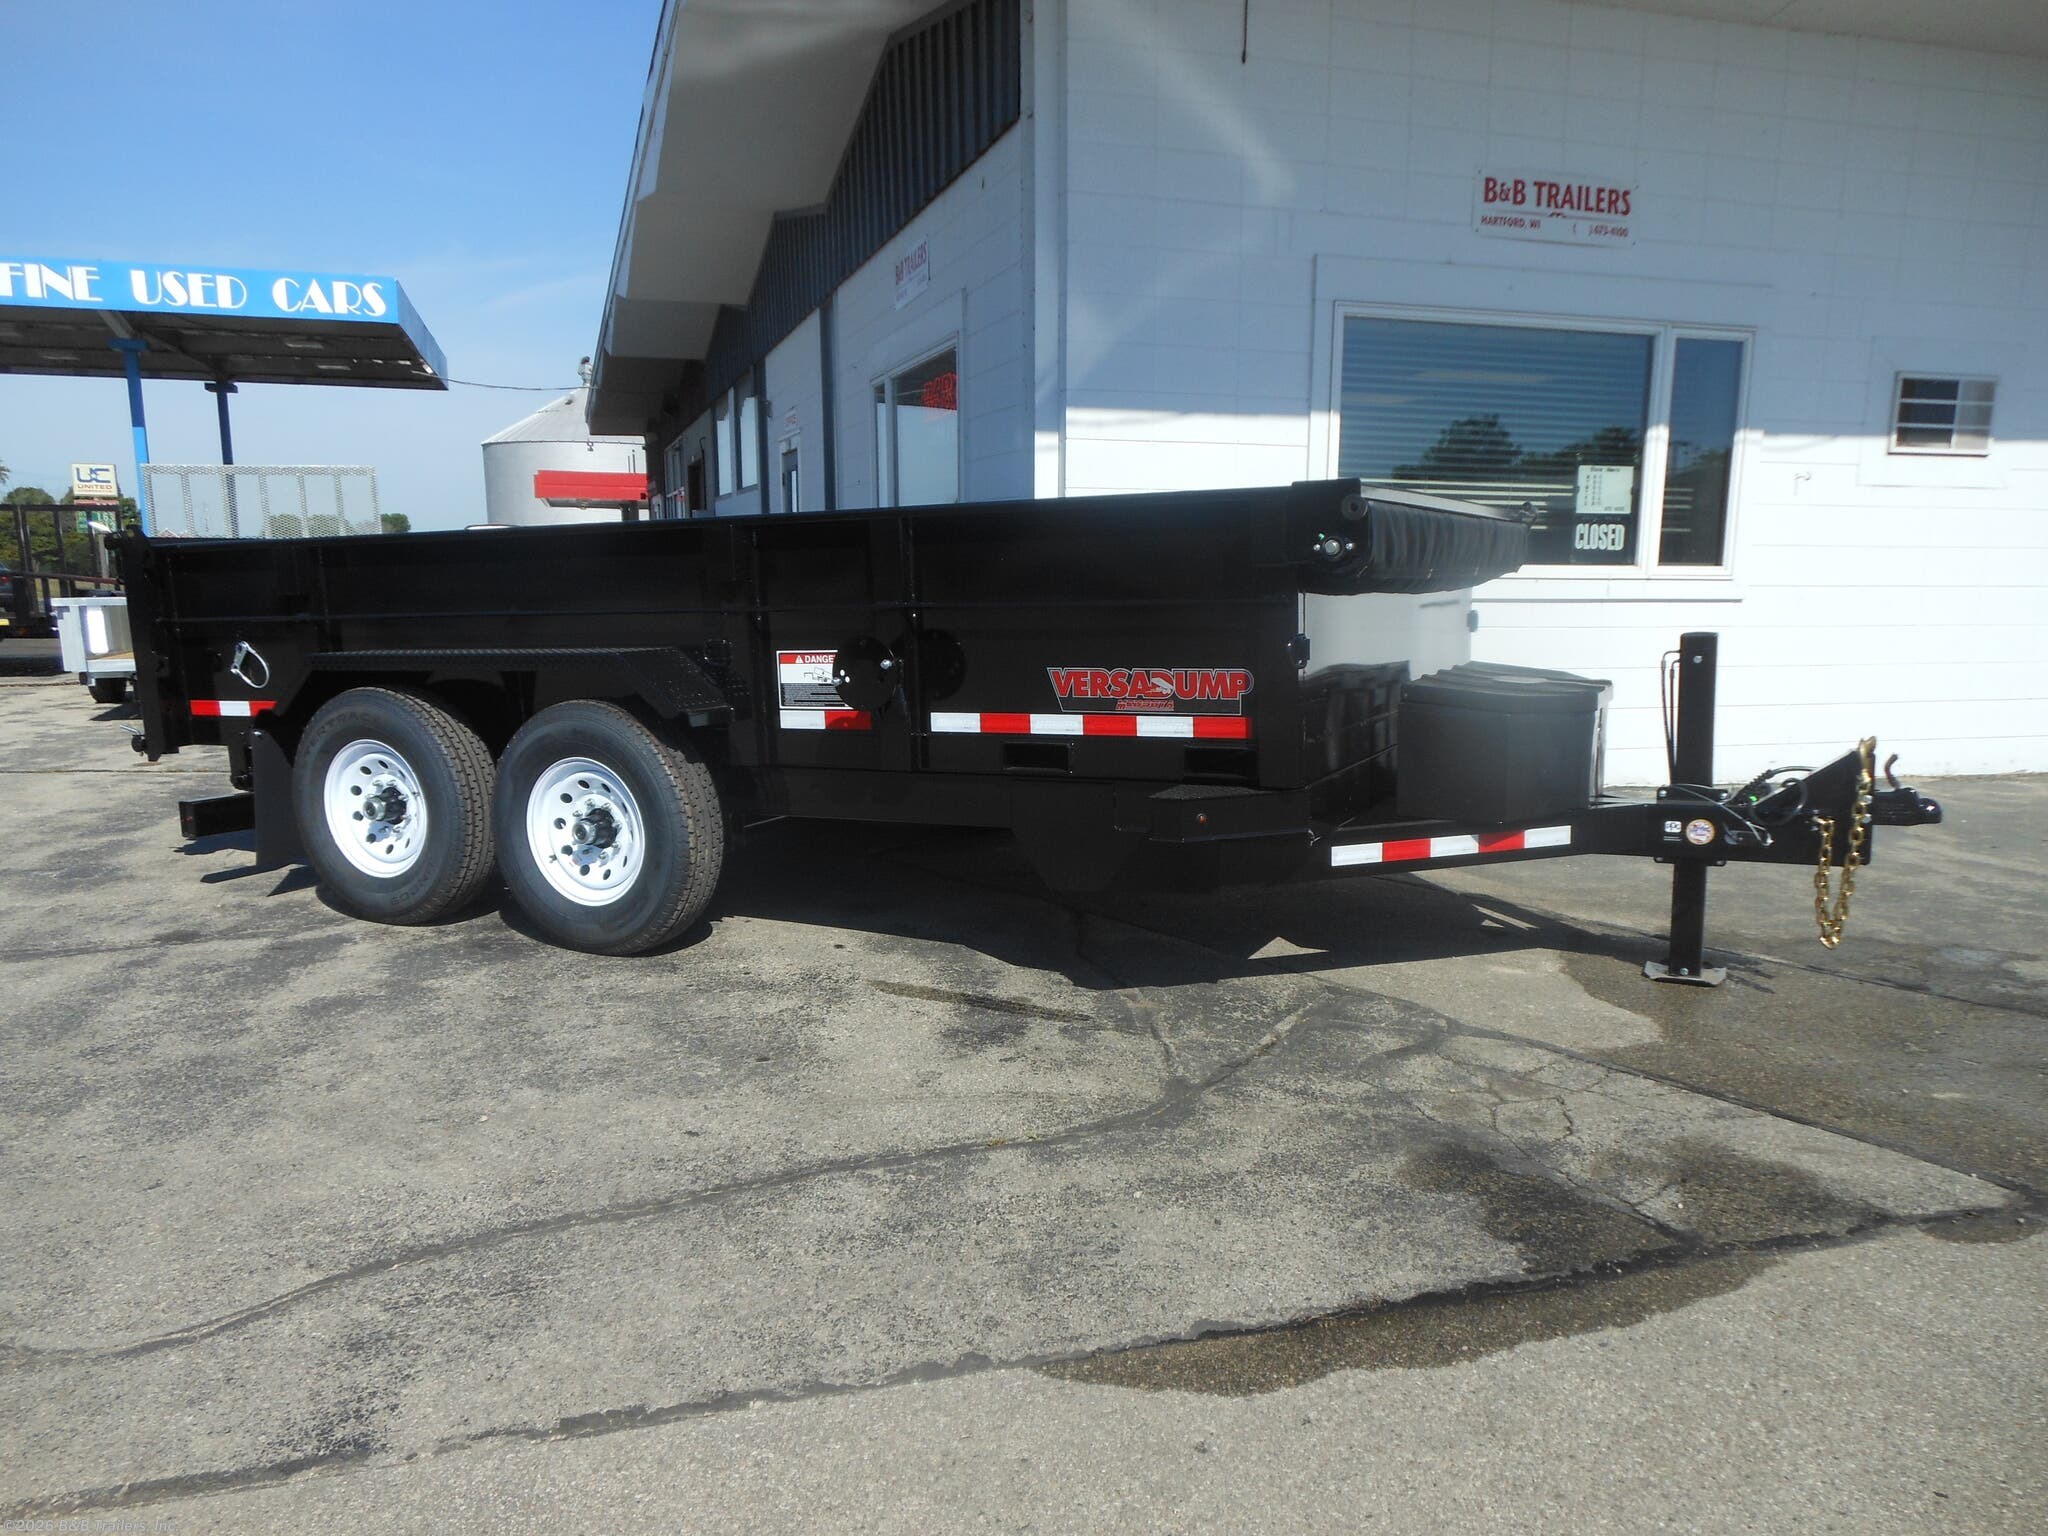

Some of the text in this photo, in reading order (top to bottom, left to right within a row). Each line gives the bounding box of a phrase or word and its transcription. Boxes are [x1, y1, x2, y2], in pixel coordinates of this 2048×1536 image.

[1483, 176, 1631, 216] B&B TRAILERS
[0, 262, 387, 317] FINE USED CARS
[1575, 523, 1625, 550] CLOSED
[804, 654, 836, 664] DANGE
[1050, 669, 1252, 700] VERSADUMP
